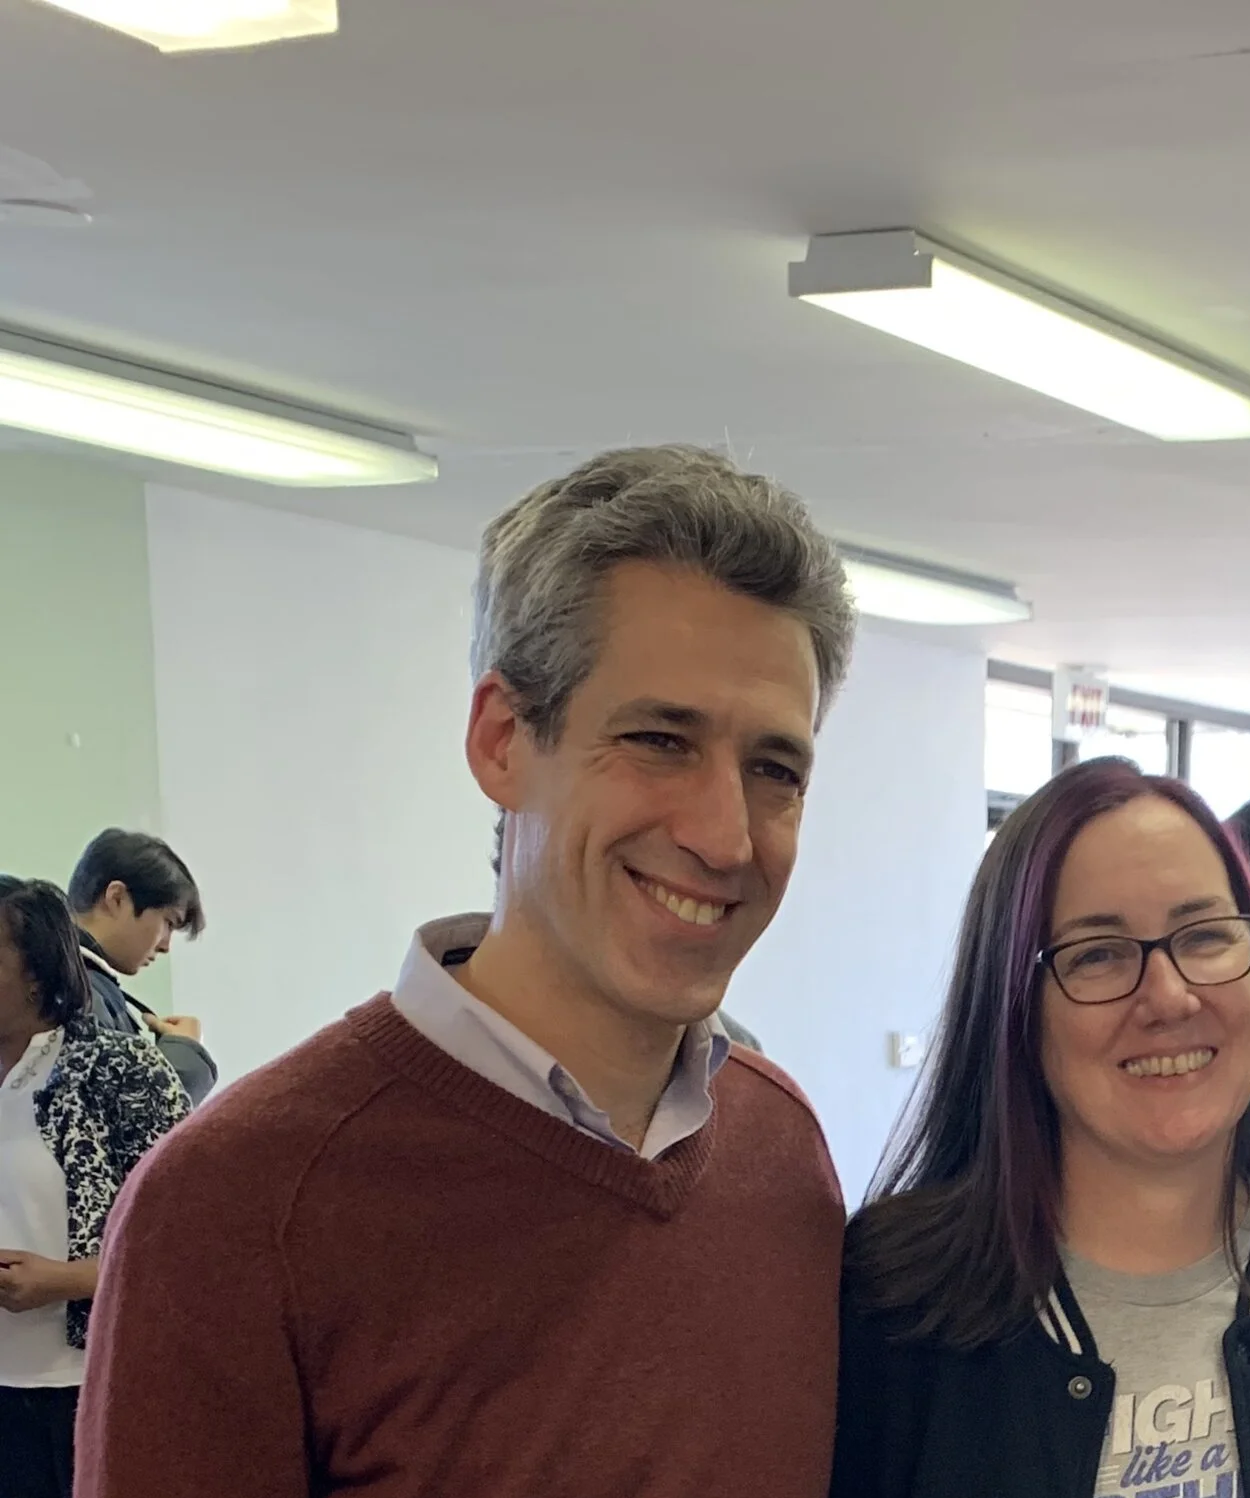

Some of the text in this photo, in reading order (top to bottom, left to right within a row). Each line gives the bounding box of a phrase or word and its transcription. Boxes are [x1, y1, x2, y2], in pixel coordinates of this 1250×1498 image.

[1112, 1378, 1235, 1456] IGH
[1120, 1440, 1231, 1488] like a
